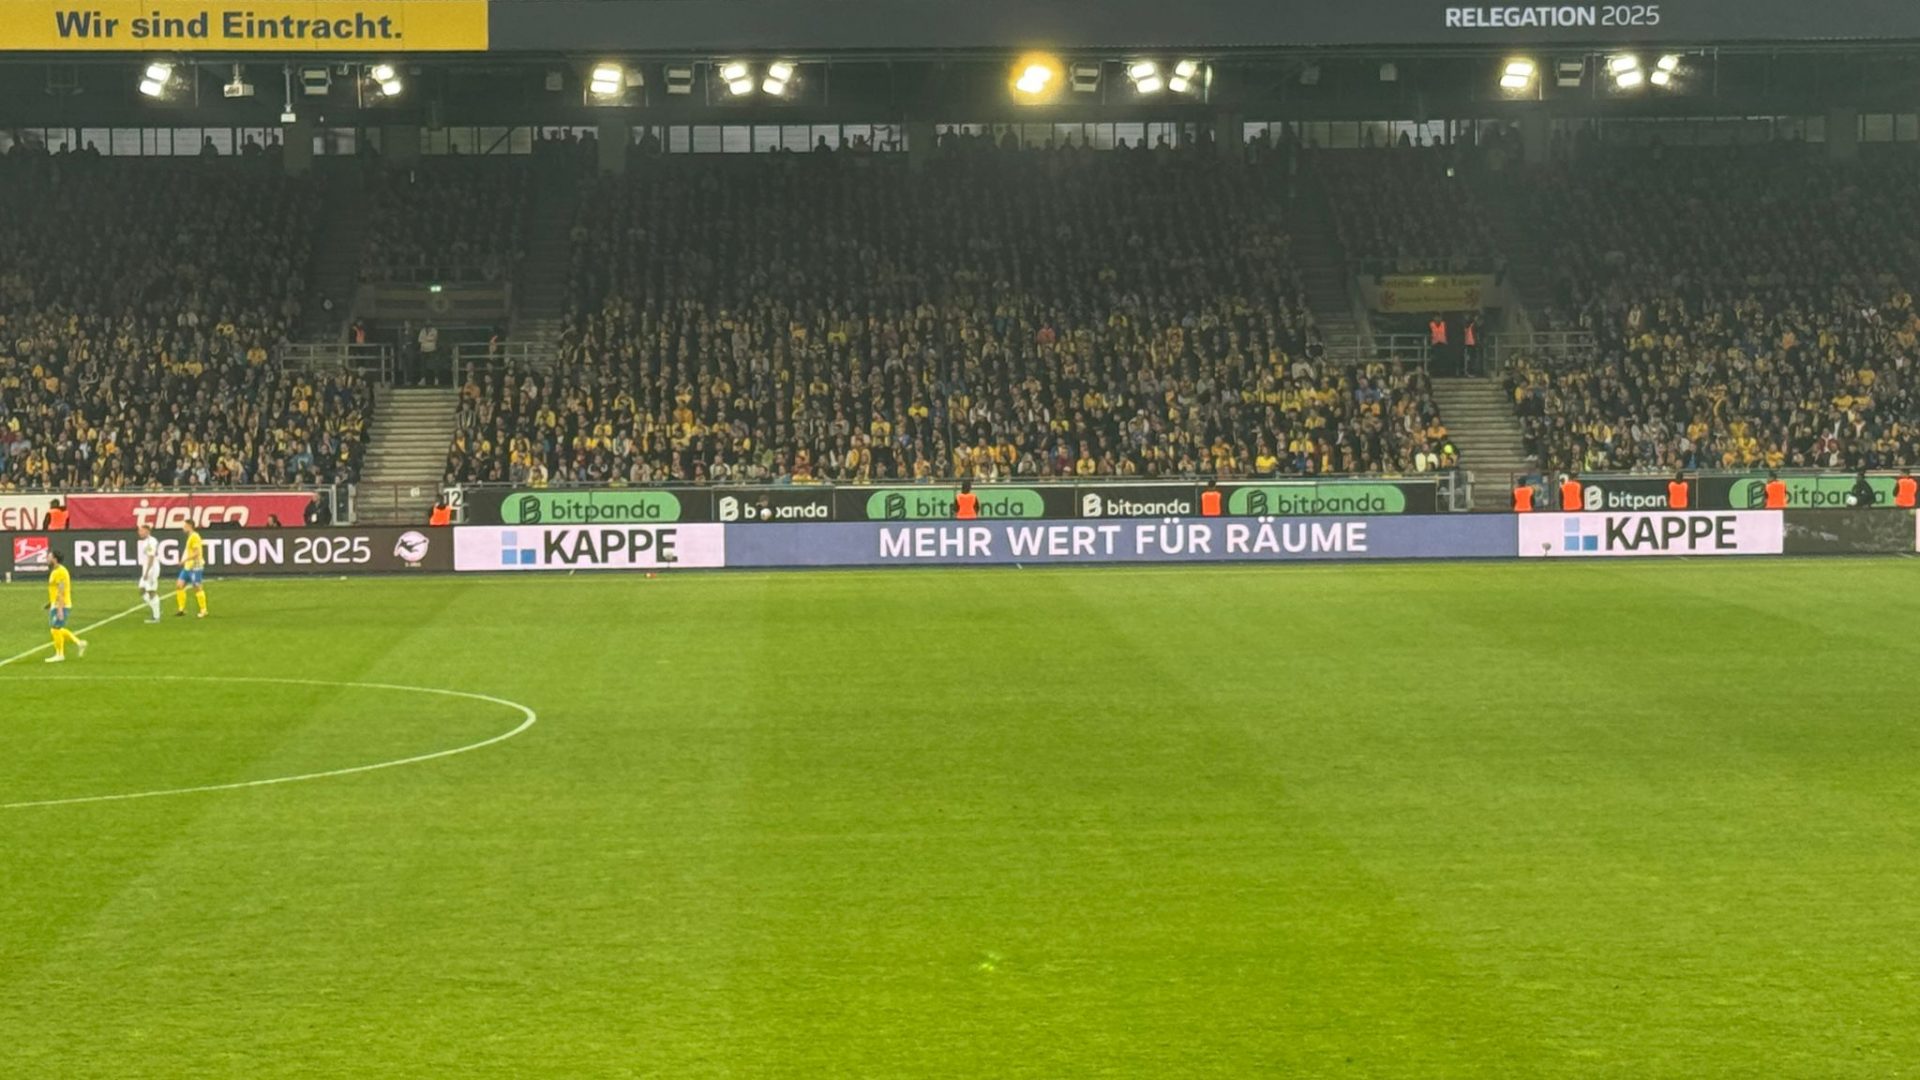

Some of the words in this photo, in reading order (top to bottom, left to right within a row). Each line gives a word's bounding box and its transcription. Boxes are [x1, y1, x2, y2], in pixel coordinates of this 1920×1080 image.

[55, 12, 119, 38] Wir
[131, 11, 209, 38] sind
[223, 11, 403, 39] Eintracht.
[1445, 6, 1595, 28] RELEGATION
[1602, 5, 1660, 26] 2025
[443, 490, 462, 507] 12
[551, 497, 660, 522] bitpanda
[916, 497, 1024, 518] bitnda
[1107, 499, 1191, 516] bitpanda
[1278, 493, 1385, 515] bitpanda
[0, 507, 38, 531] EN
[879, 527, 992, 557] MEHR
[1007, 525, 1121, 556] WERT
[1136, 518, 1212, 555] FÜR
[1226, 516, 1368, 553] RÄUME
[1606, 516, 1737, 551] KAPPE
[74, 537, 284, 566] RELGTION
[293, 536, 371, 564] 2025
[544, 529, 678, 564] KAPPE
